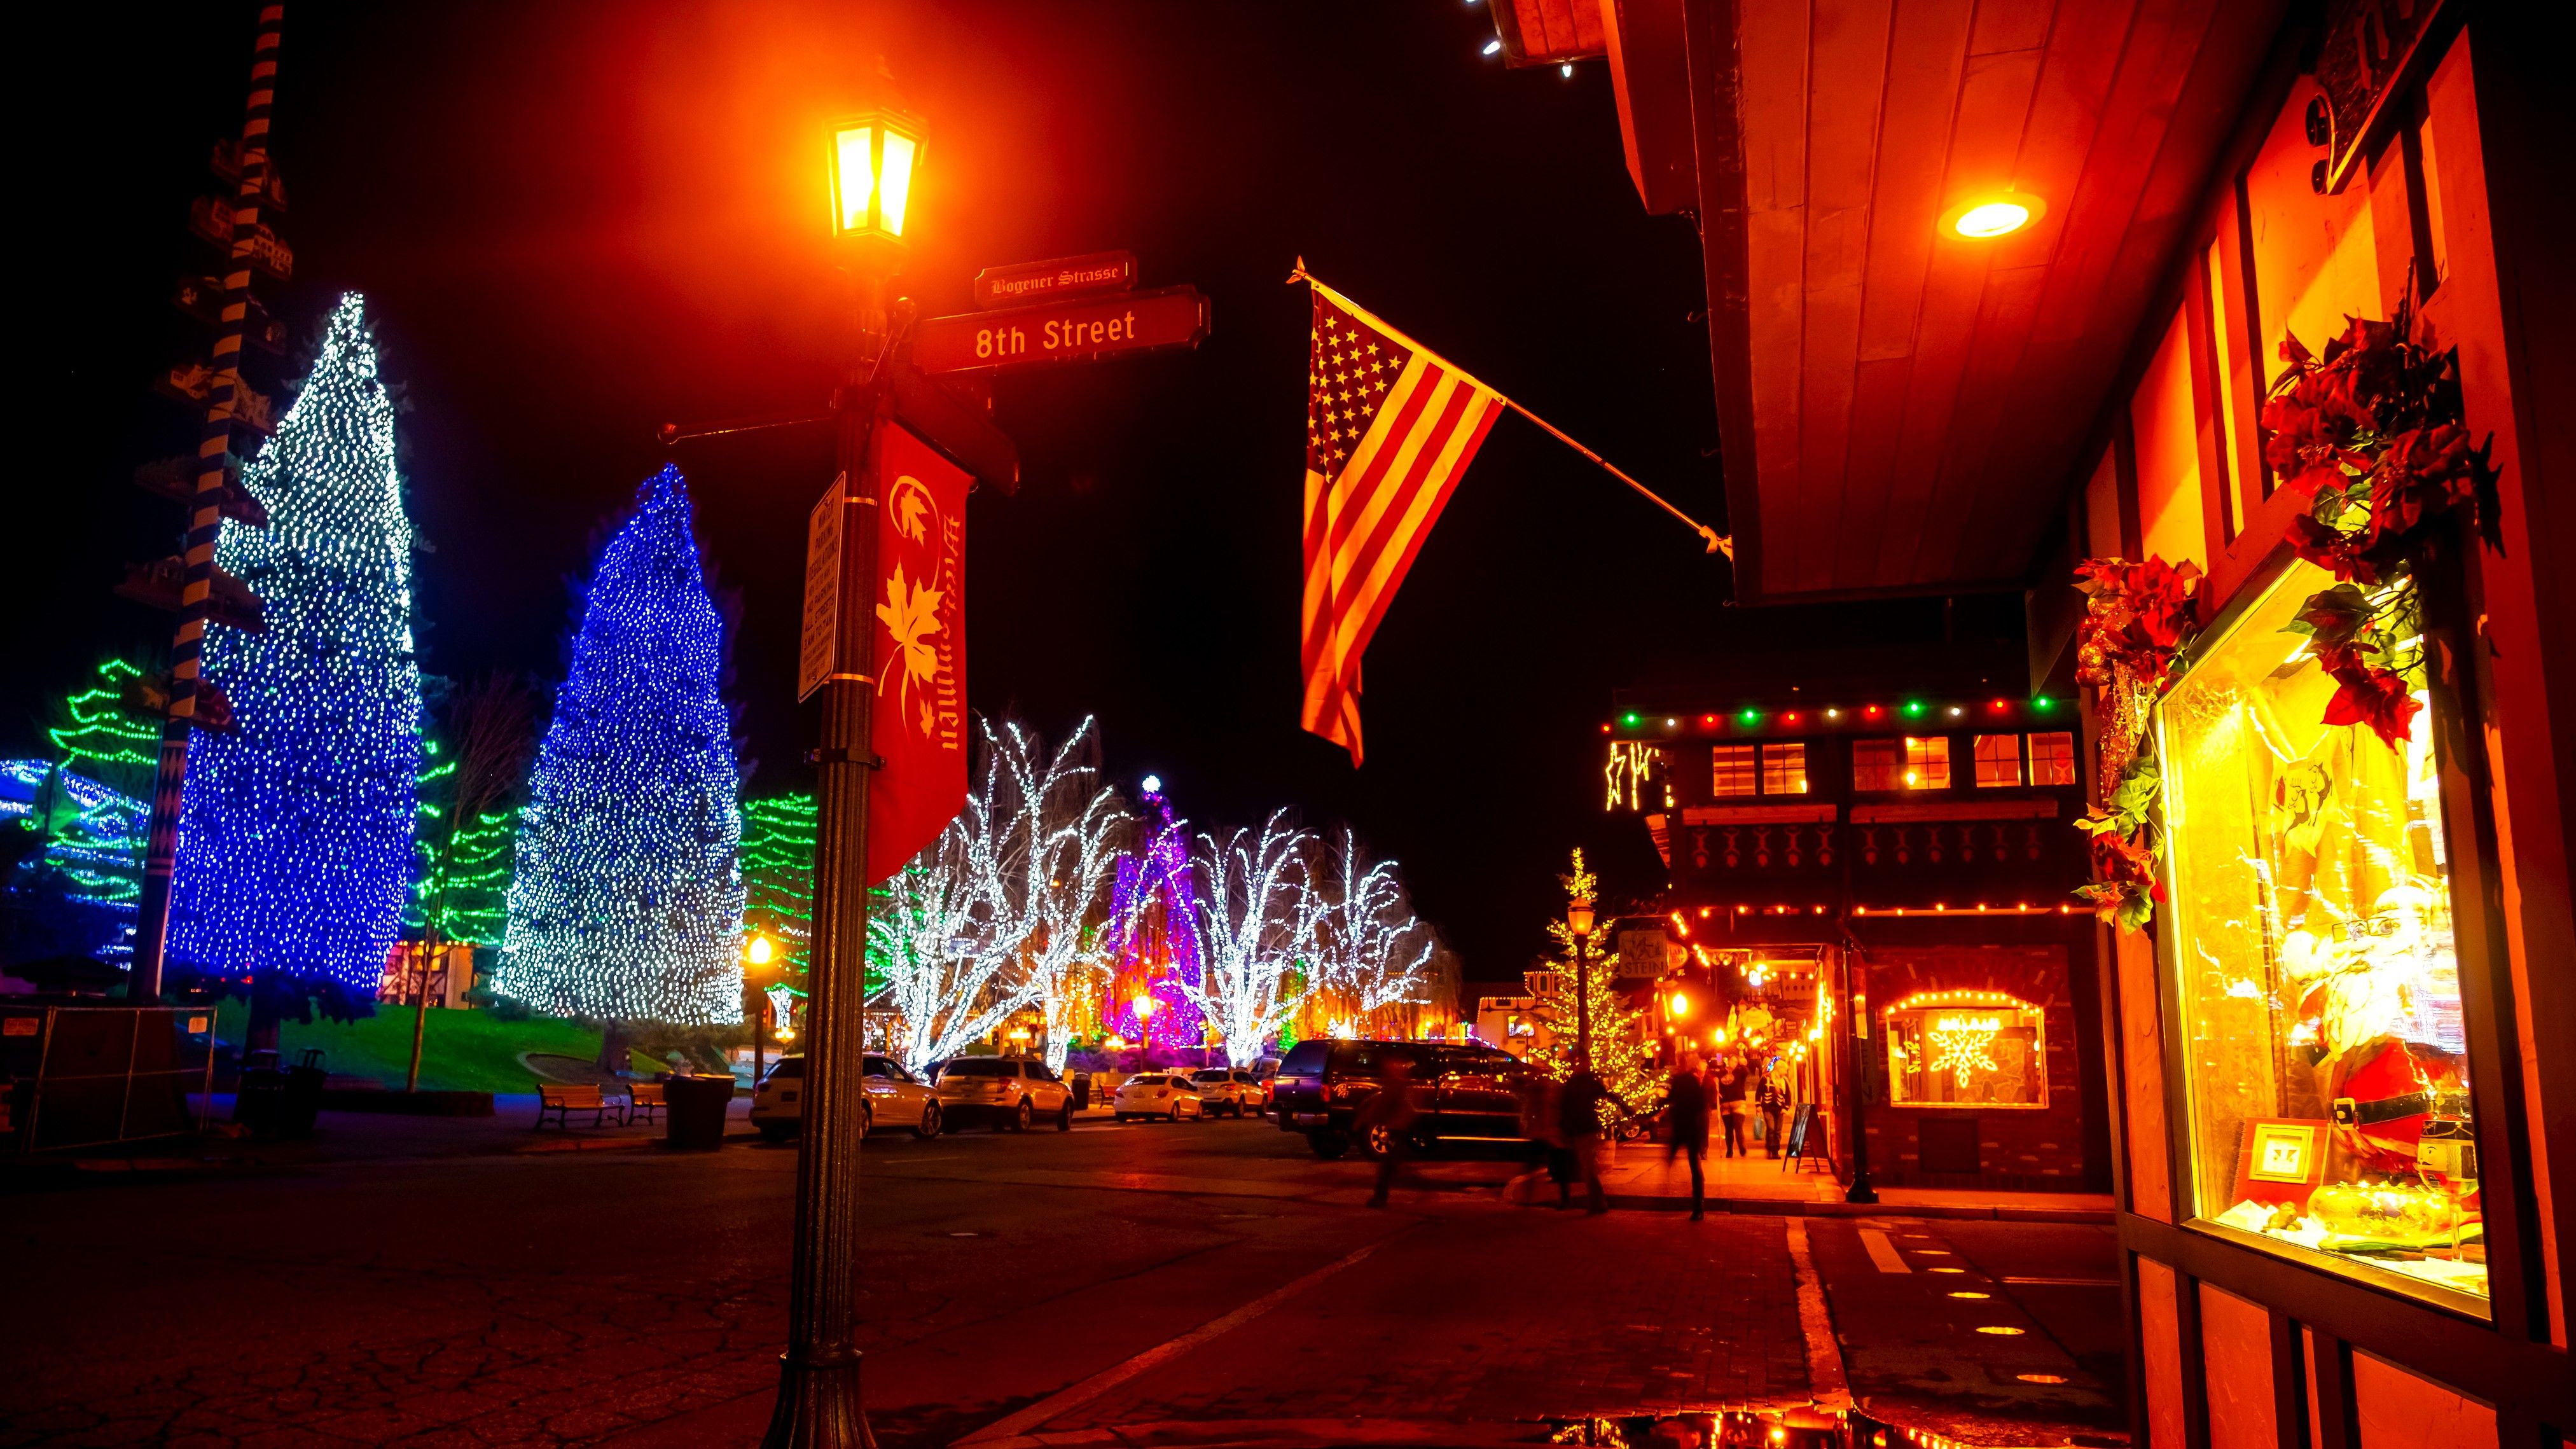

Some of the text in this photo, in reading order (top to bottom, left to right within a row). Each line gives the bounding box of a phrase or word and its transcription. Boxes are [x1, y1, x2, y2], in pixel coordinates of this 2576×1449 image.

[992, 268, 1119, 295] Bogener Strasse
[975, 310, 1135, 358] 8th Street
[814, 592, 834, 625] STREETS
[1624, 961, 1665, 974] STEIN
